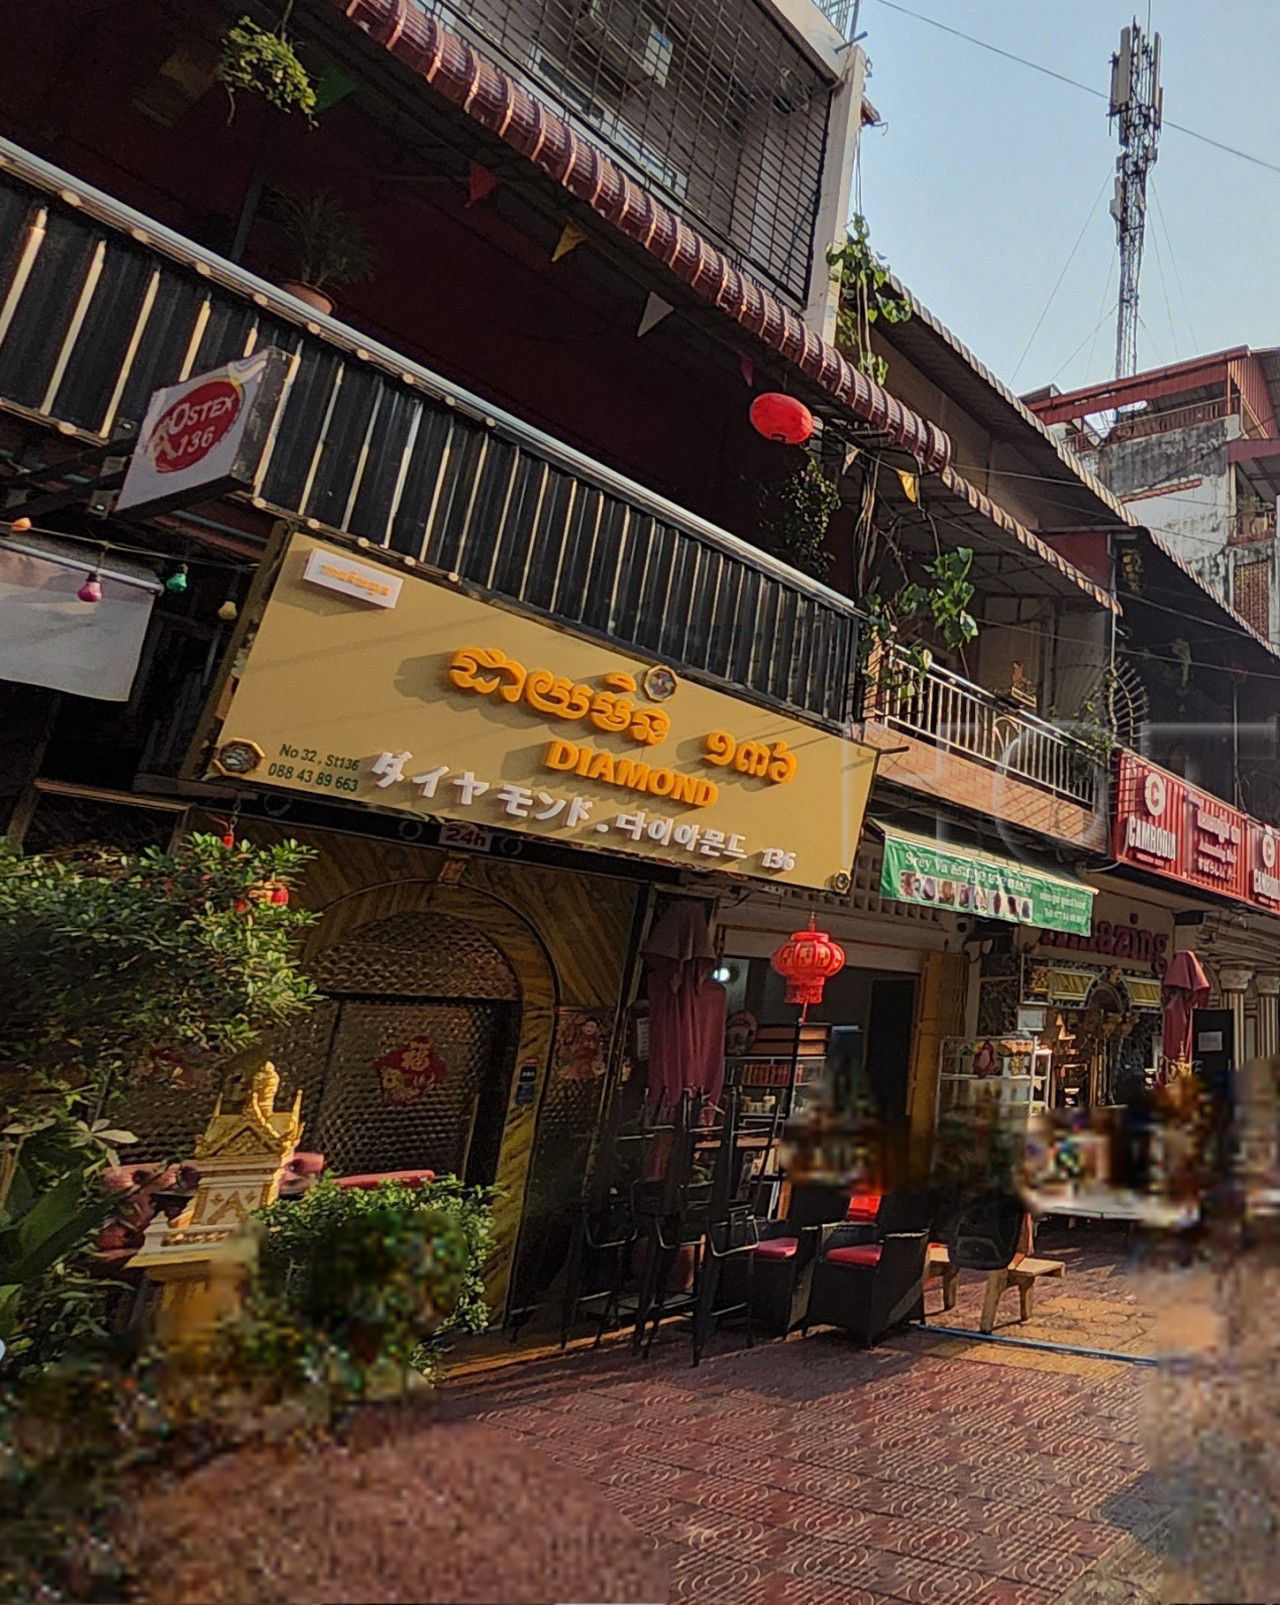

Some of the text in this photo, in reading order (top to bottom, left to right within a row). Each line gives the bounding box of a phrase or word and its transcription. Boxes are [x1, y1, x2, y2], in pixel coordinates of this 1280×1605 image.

[176, 426, 215, 456] 136
[279, 743, 299, 758] No
[324, 754, 360, 771] St136
[546, 740, 718, 808] DIAMOND
[703, 730, 797, 784] ១៣៦
[268, 762, 359, 792] 088 43 89 663
[446, 825, 487, 847] 24h
[615, 812, 748, 859] 다이아몬드
[762, 848, 797, 872] 136
[1128, 815, 1176, 861] CAMBODIA
